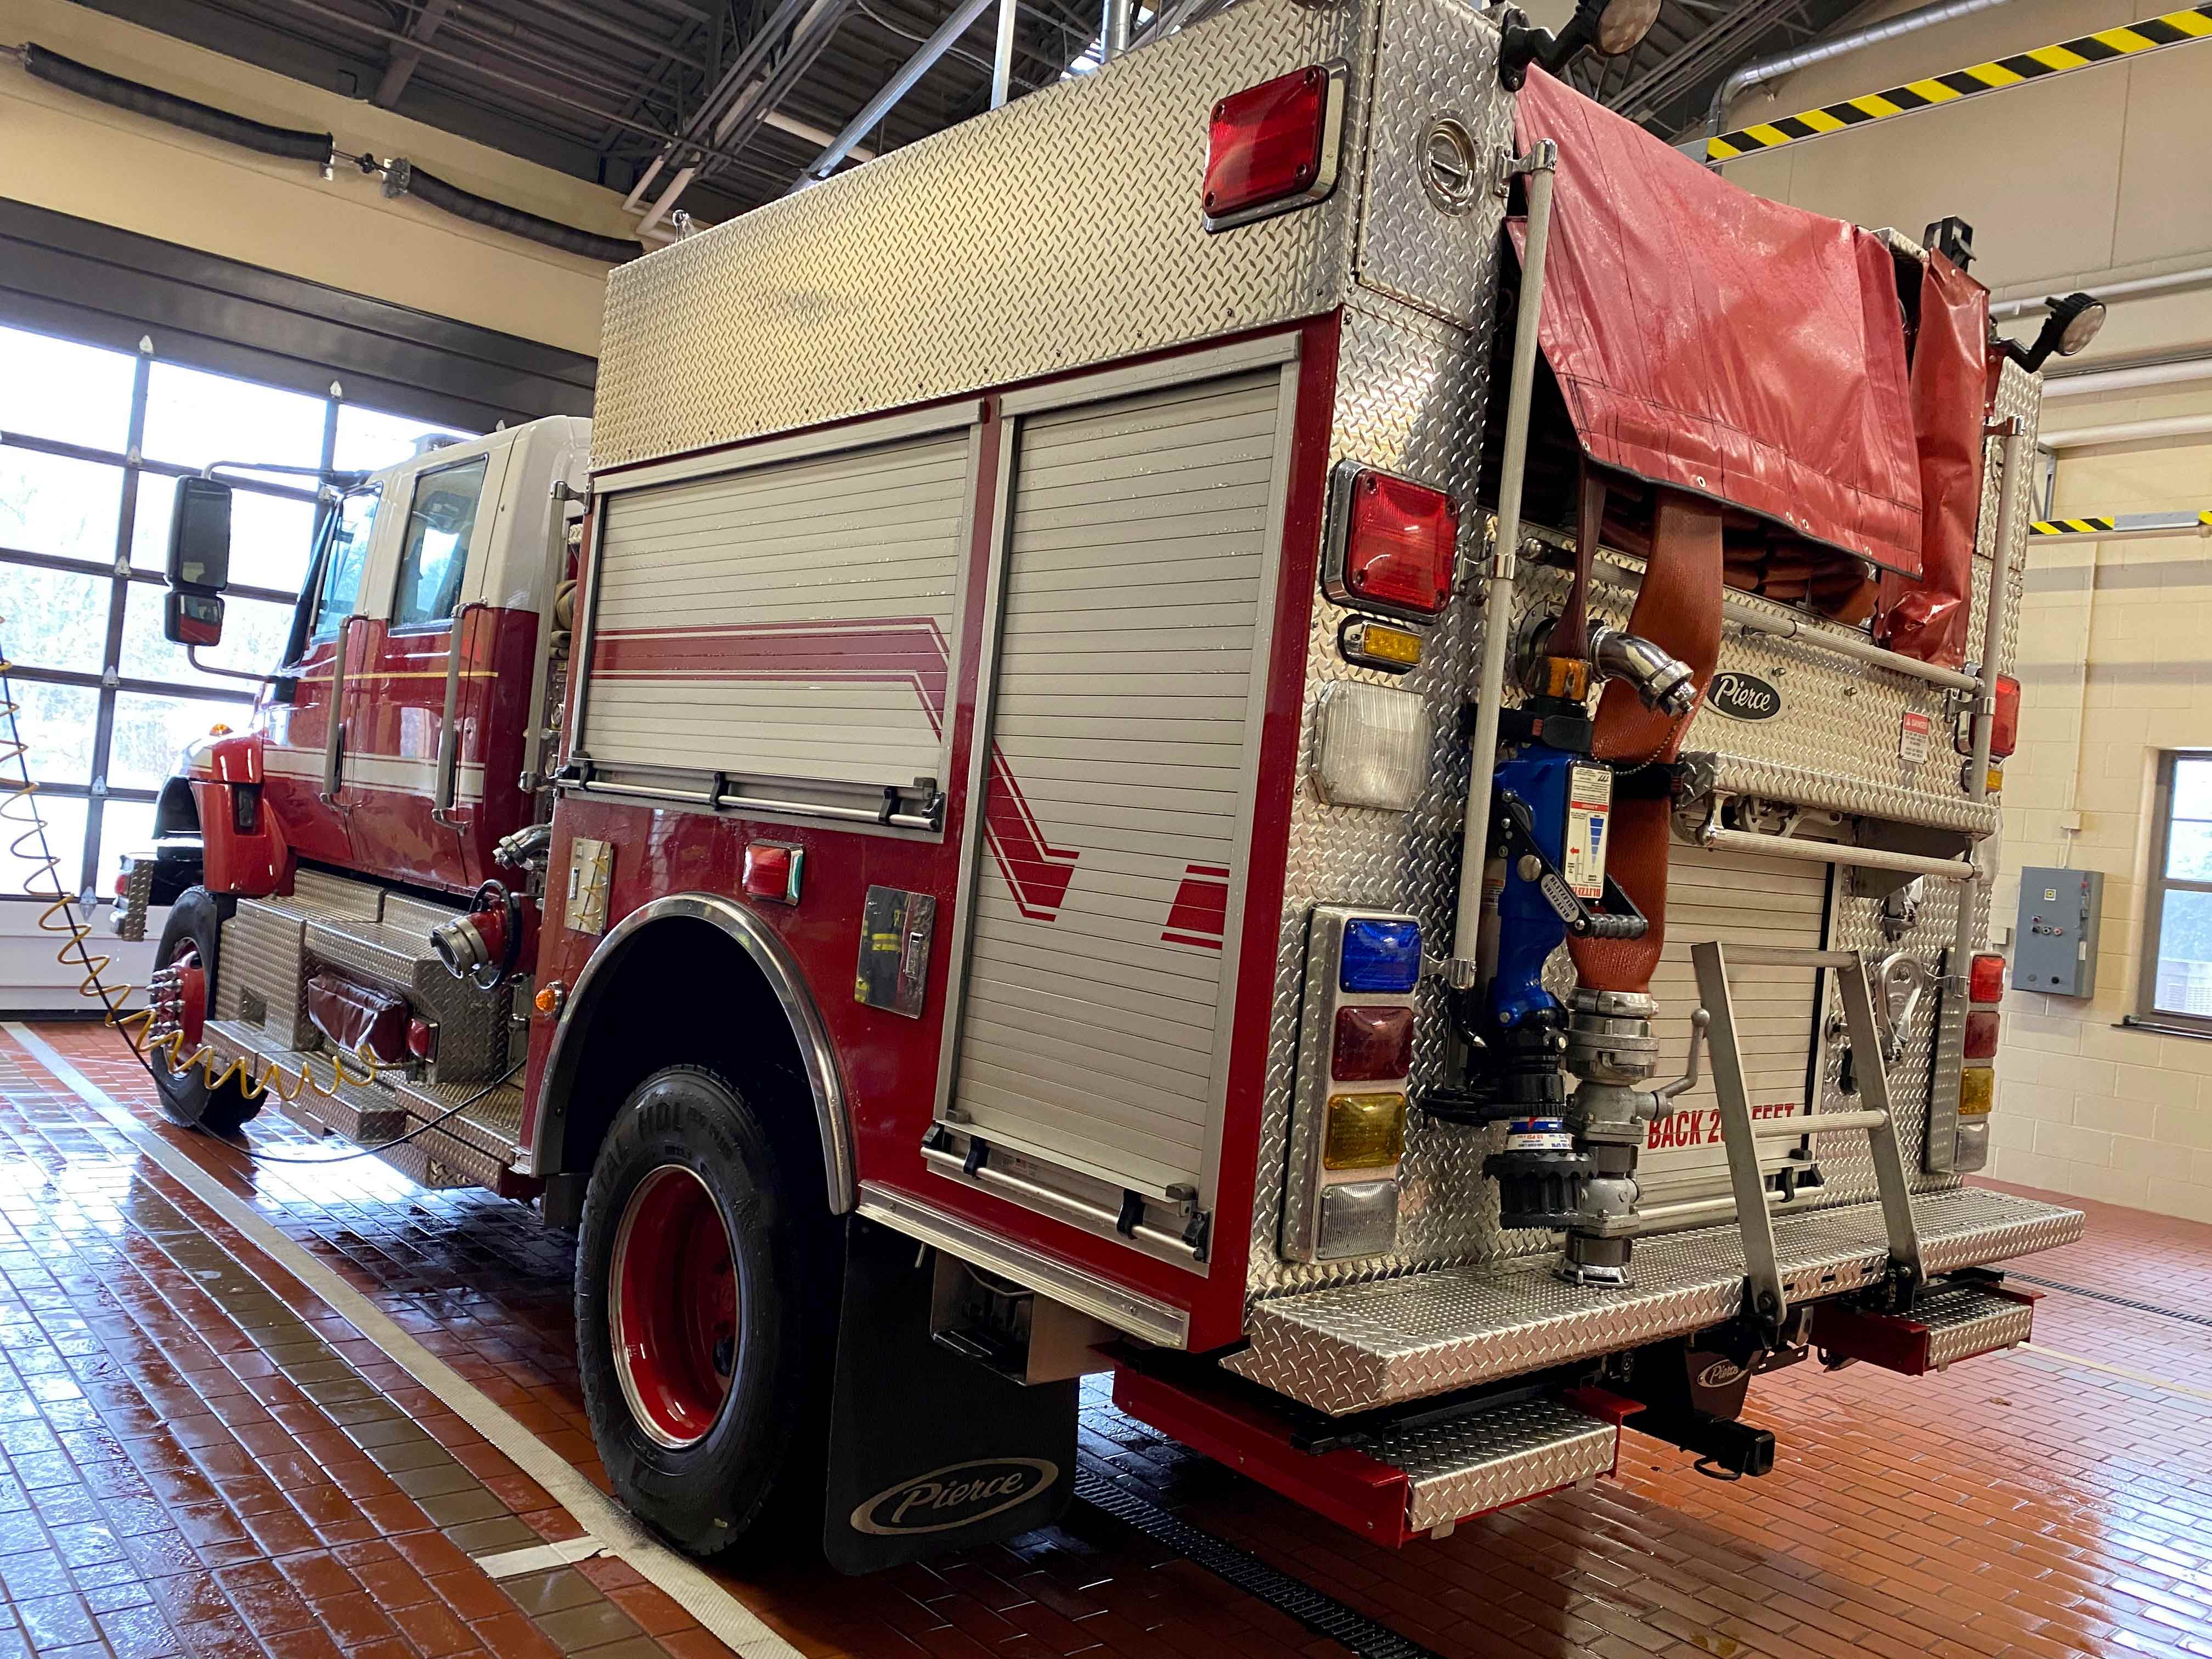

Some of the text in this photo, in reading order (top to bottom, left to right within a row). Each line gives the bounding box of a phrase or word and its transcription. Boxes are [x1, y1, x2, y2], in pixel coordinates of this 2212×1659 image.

[1714, 675, 1770, 712] Pierce
[1543, 882, 1570, 918] BLITZFIRE
[1550, 877, 1577, 913] BLITZFIRE
[1647, 1110, 1703, 1149] BACK
[891, 1472, 1023, 1523] Pierce
